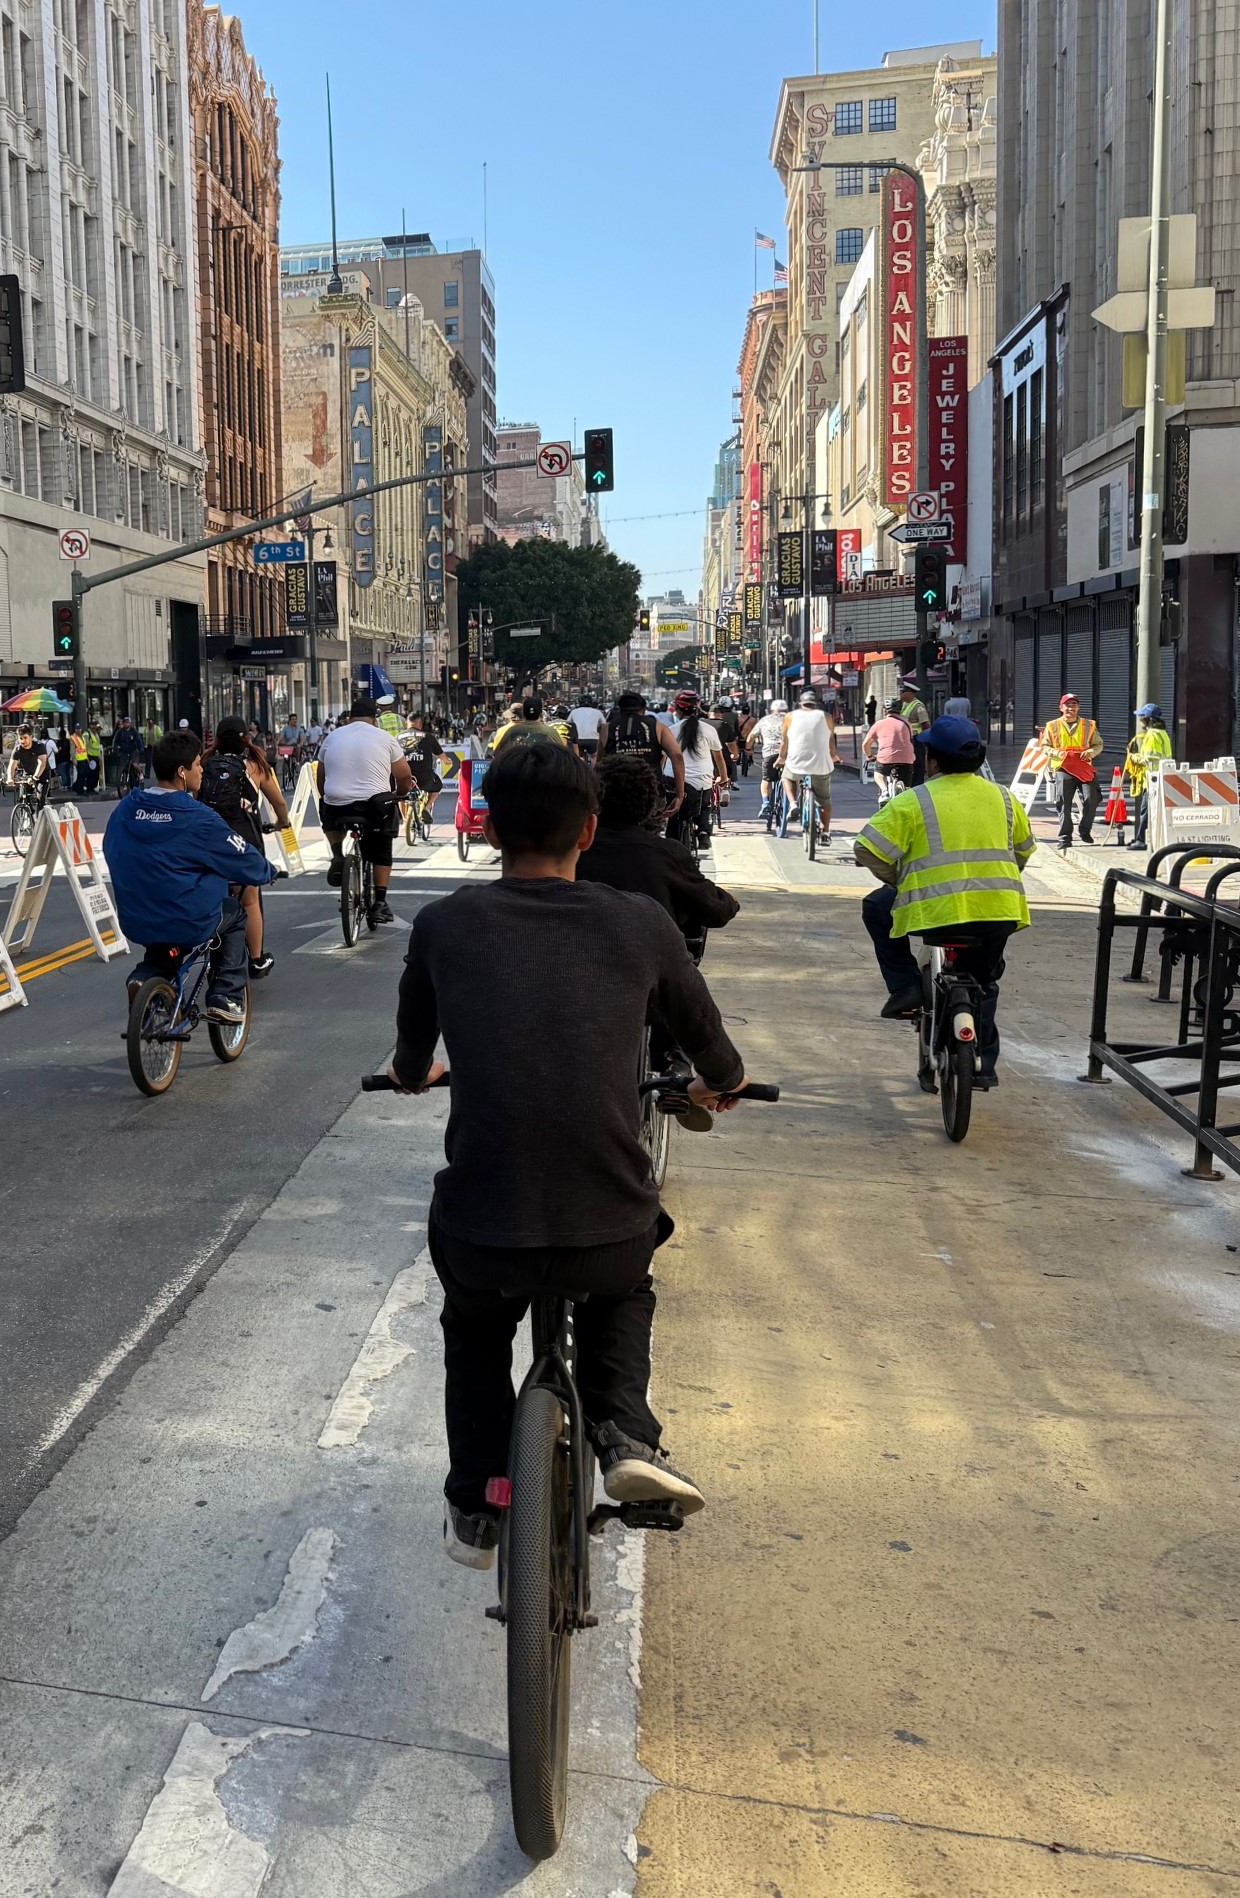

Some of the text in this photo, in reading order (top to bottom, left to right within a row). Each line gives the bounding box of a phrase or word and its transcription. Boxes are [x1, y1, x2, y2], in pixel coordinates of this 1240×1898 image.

[891, 189, 913, 495] LOS ANGELES
[940, 340, 956, 348] LOS
[930, 349, 966, 357] ANGELES
[935, 363, 959, 471] JEWELRY
[350, 367, 372, 572] PALACE
[425, 441, 442, 600] PALACE
[907, 527, 945, 537] ONE WAY
[259, 546, 300, 559] 6th St
[816, 542, 833, 551] Phil
[781, 537, 791, 585] GRACIAS
[791, 537, 801, 585] GUSTAVO
[317, 574, 333, 582] Phil
[288, 568, 297, 612] GRACIAS
[297, 568, 305, 613] GUSTAVO
[842, 581, 862, 593] LOS
[938, 647, 944, 660] 2
[135, 809, 173, 822] Dodgers
[226, 834, 247, 854] LA
